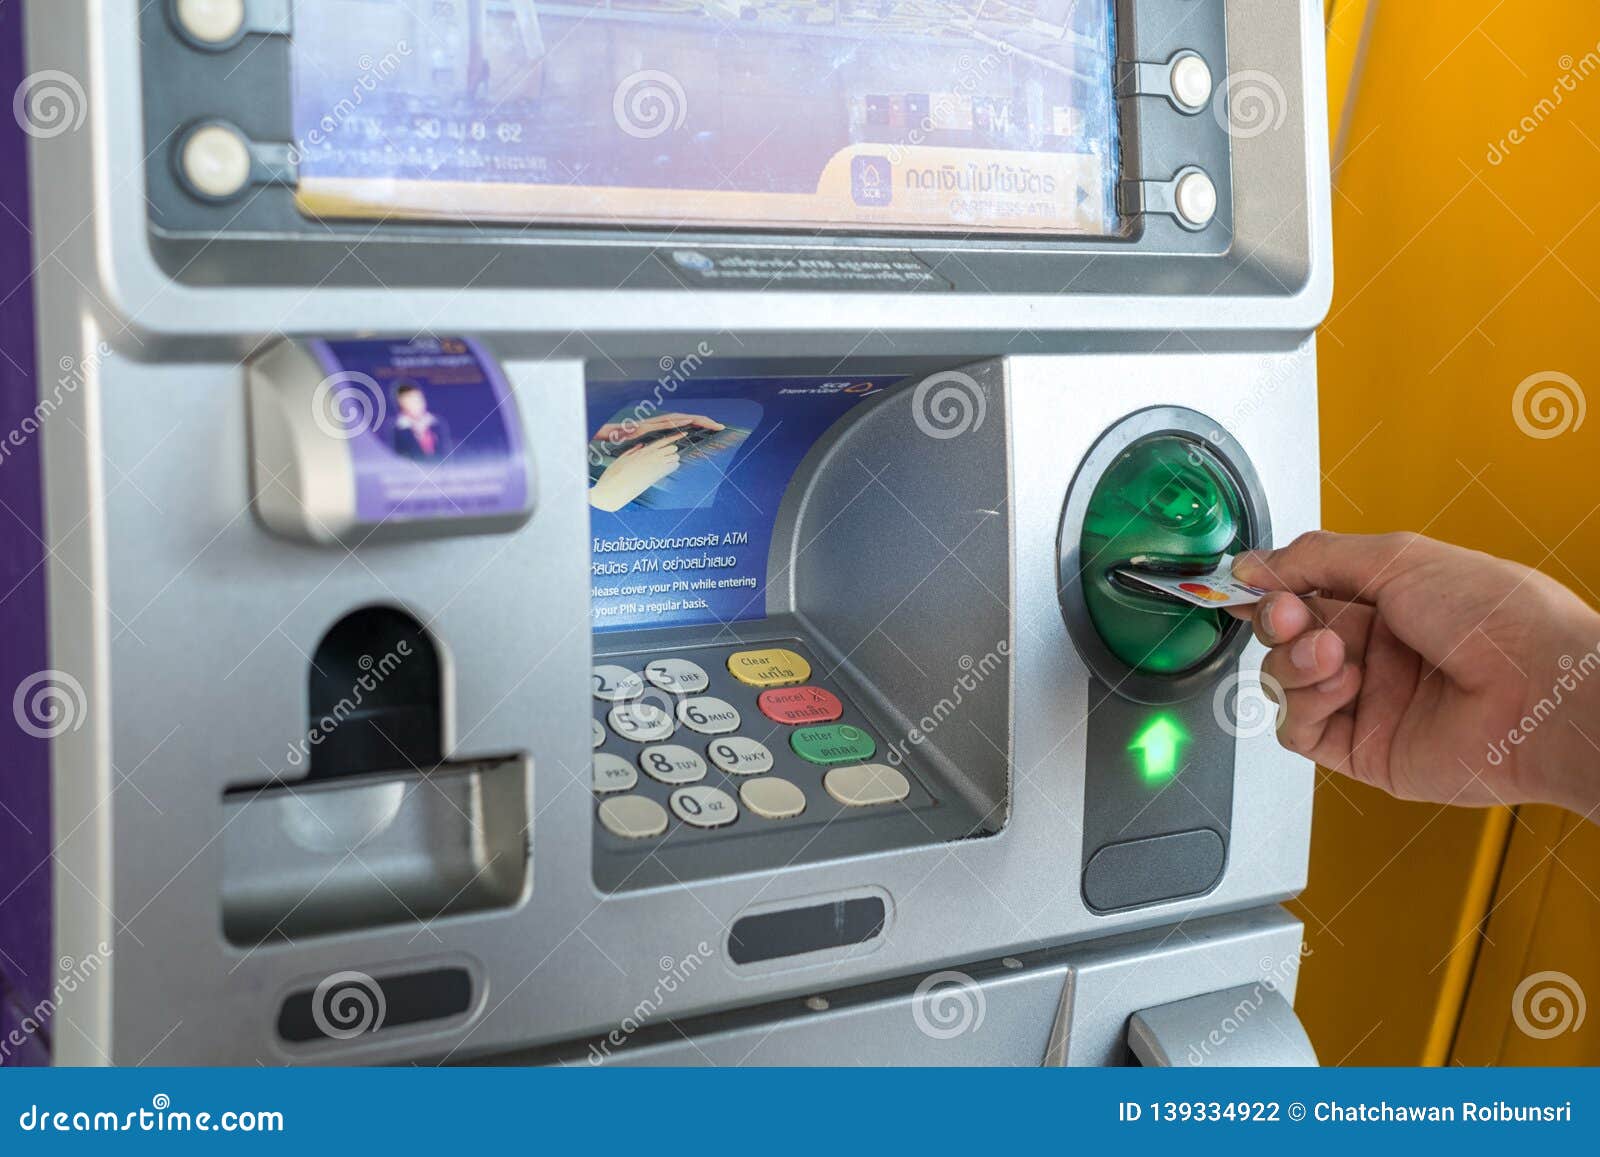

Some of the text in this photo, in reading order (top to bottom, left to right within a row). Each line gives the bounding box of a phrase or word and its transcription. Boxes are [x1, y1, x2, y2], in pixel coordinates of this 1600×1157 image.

[905, 162, 1056, 193] กดเงินไม่ใช้บัตร
[722, 532, 748, 544] ATM
[631, 559, 658, 573] ATM
[620, 584, 647, 595] cover
[648, 583, 671, 596] your
[672, 581, 688, 591] PIN
[690, 578, 717, 590] while
[717, 576, 757, 589] entering
[595, 606, 618, 619] your
[619, 603, 637, 614] PIN
[638, 604, 645, 613] a
[646, 600, 680, 614] regular
[682, 598, 709, 609] basis.
[741, 656, 770, 666] Clear
[592, 674, 614, 692] 2
[651, 667, 702, 685] 3 DEF
[766, 693, 805, 704] Cancel
[615, 712, 640, 731] 5
[686, 705, 735, 725] 6 MNO
[800, 731, 833, 742] Enter
[648, 752, 698, 773] 8 TUV
[716, 744, 766, 765] 9 WXY
[605, 768, 630, 778] PRS
[678, 794, 703, 815] 0
